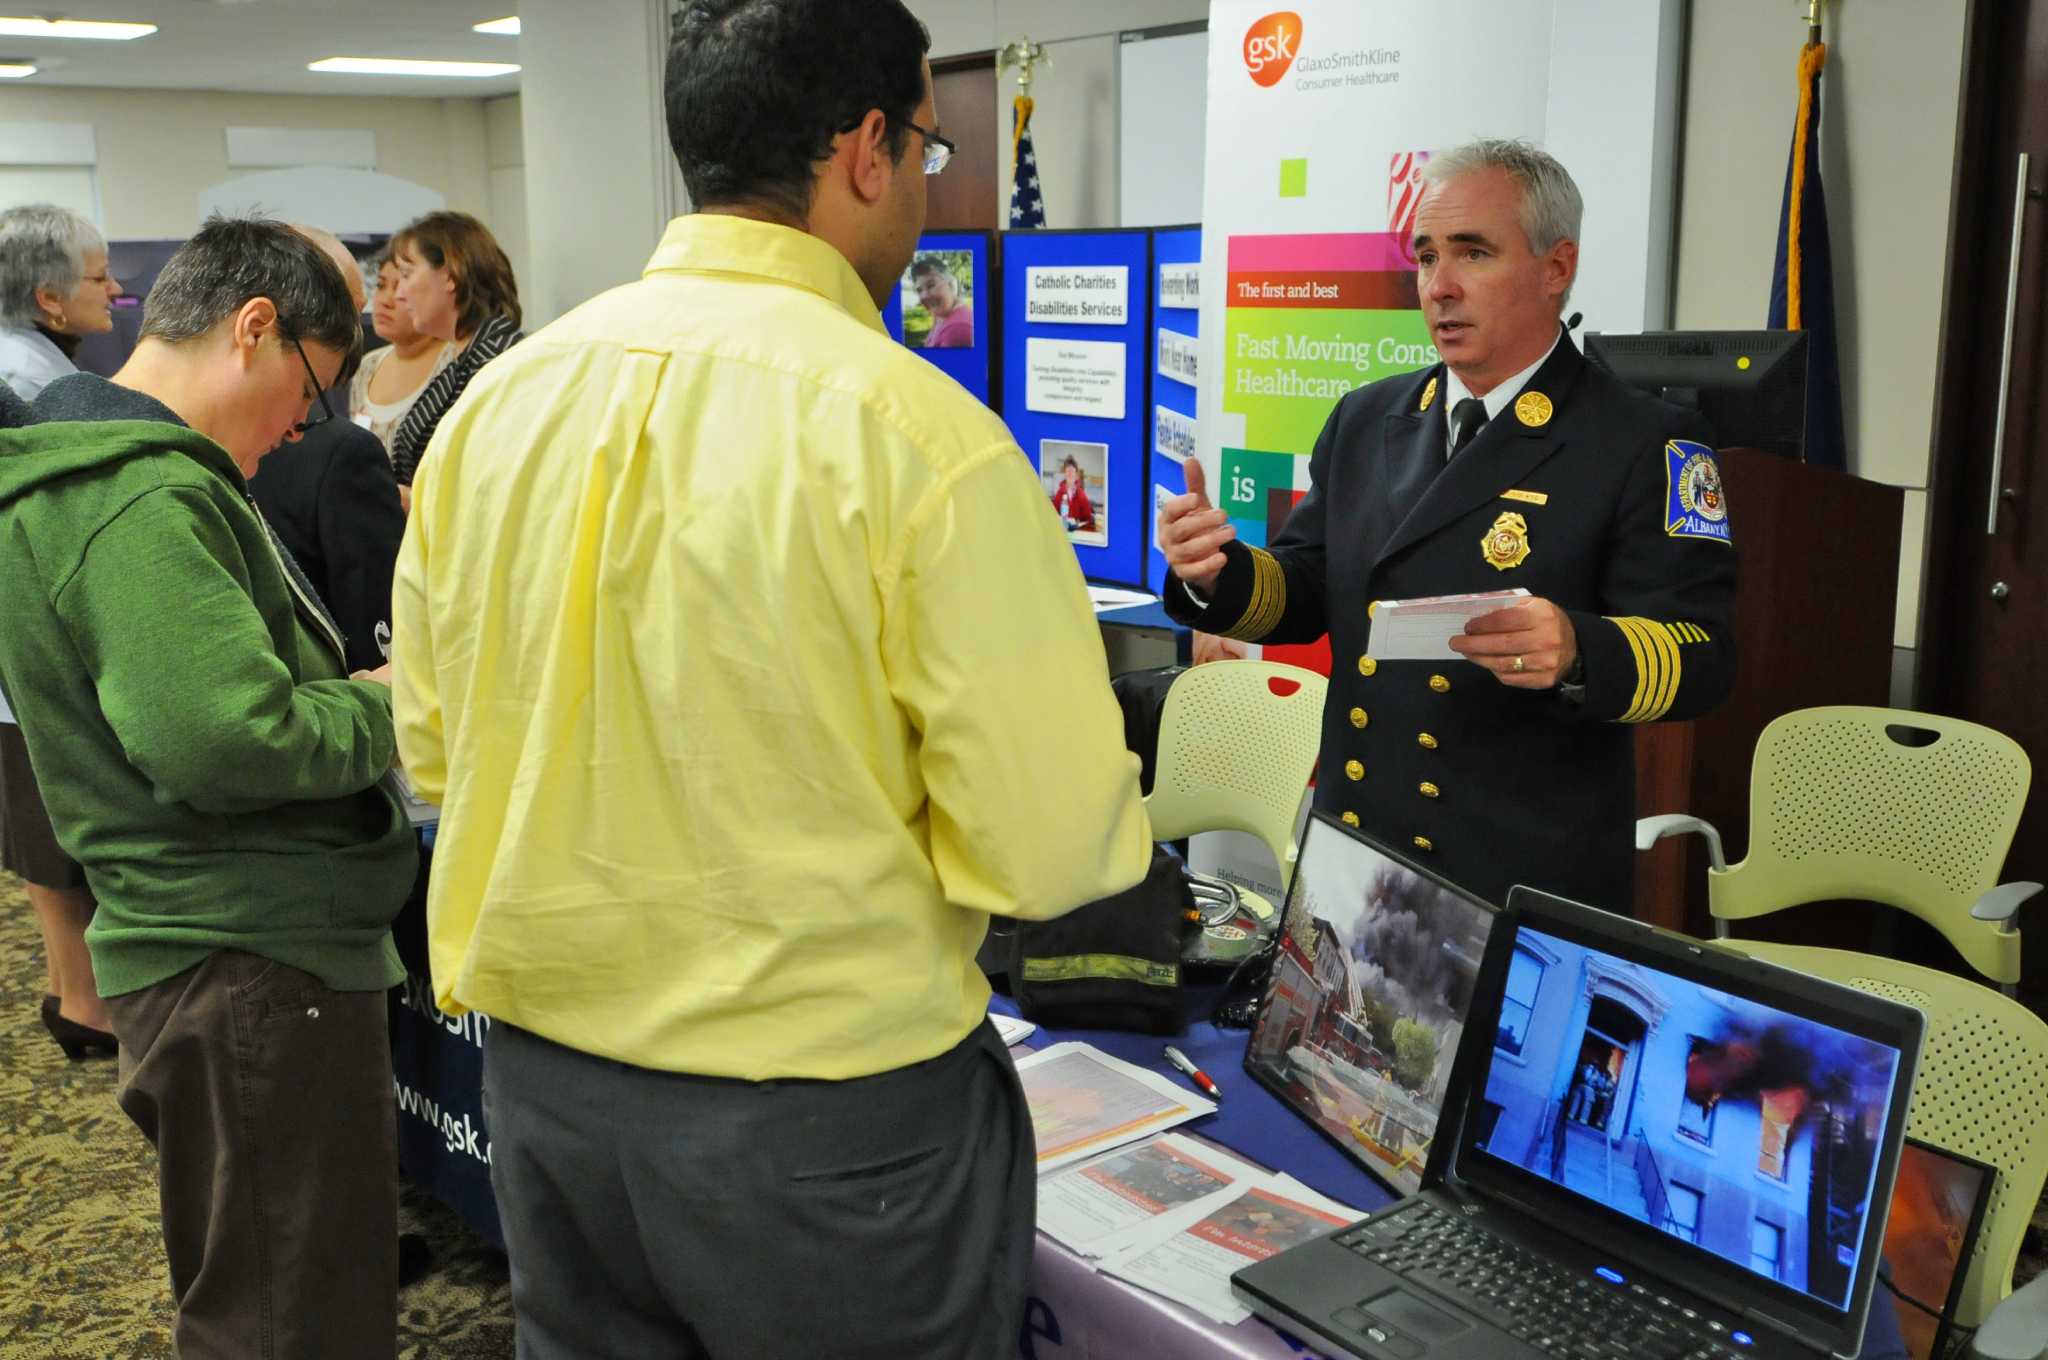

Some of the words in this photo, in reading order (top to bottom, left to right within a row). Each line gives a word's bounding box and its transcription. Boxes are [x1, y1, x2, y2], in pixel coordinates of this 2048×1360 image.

[1247, 25, 1294, 72] gsk
[1296, 48, 1400, 73] GlaxoSmithKline
[1296, 76, 1343, 91] Consumer
[1345, 71, 1400, 86] Healthcare
[1035, 274, 1071, 290] Catholic
[1074, 274, 1117, 290] Charities
[1237, 281, 1259, 298] The
[1262, 281, 1285, 298] first
[1287, 282, 1311, 299] and
[1312, 282, 1339, 299] best
[1029, 301, 1079, 316] Disabilities
[1081, 301, 1123, 317] Services
[1236, 333, 1280, 360] Fast
[1285, 333, 1371, 371] Moving
[1376, 336, 1440, 366] Cons
[1235, 368, 1351, 399] Healthcare
[1230, 465, 1256, 502] is
[1216, 867, 1255, 891] Helping
[1256, 882, 1282, 898] more
